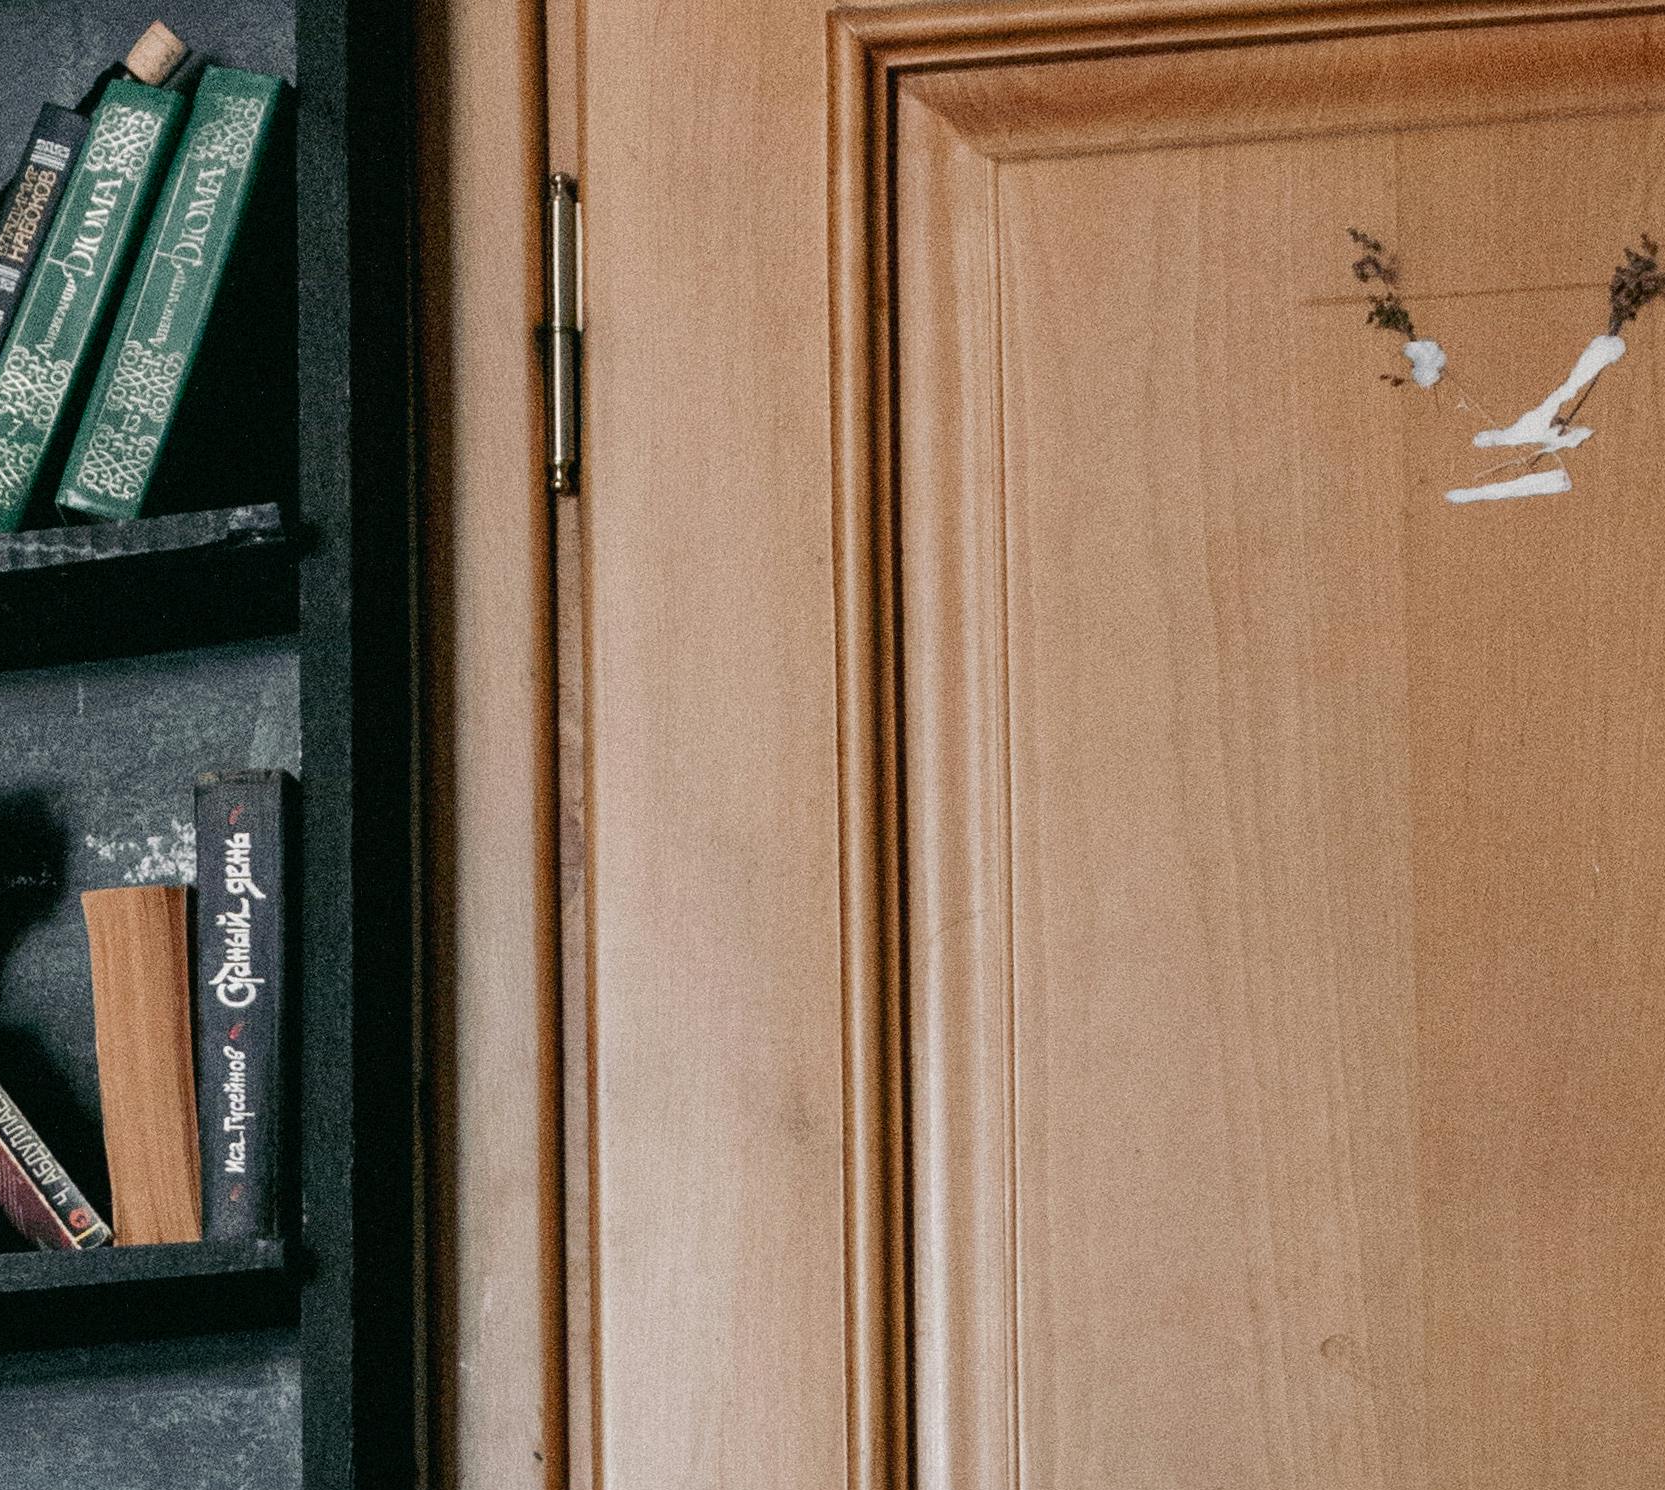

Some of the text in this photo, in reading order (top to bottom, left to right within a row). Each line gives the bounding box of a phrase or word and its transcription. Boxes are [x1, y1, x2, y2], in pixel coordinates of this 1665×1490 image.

[5, 168, 57, 264] НАБОКОВ
[60, 178, 123, 279] ДЮМА
[171, 165, 227, 269] ДЮМА
[120, 413, 142, 434] 12
[225, 831, 268, 900] день
[222, 1045, 257, 1176] Иса Гусейнов
